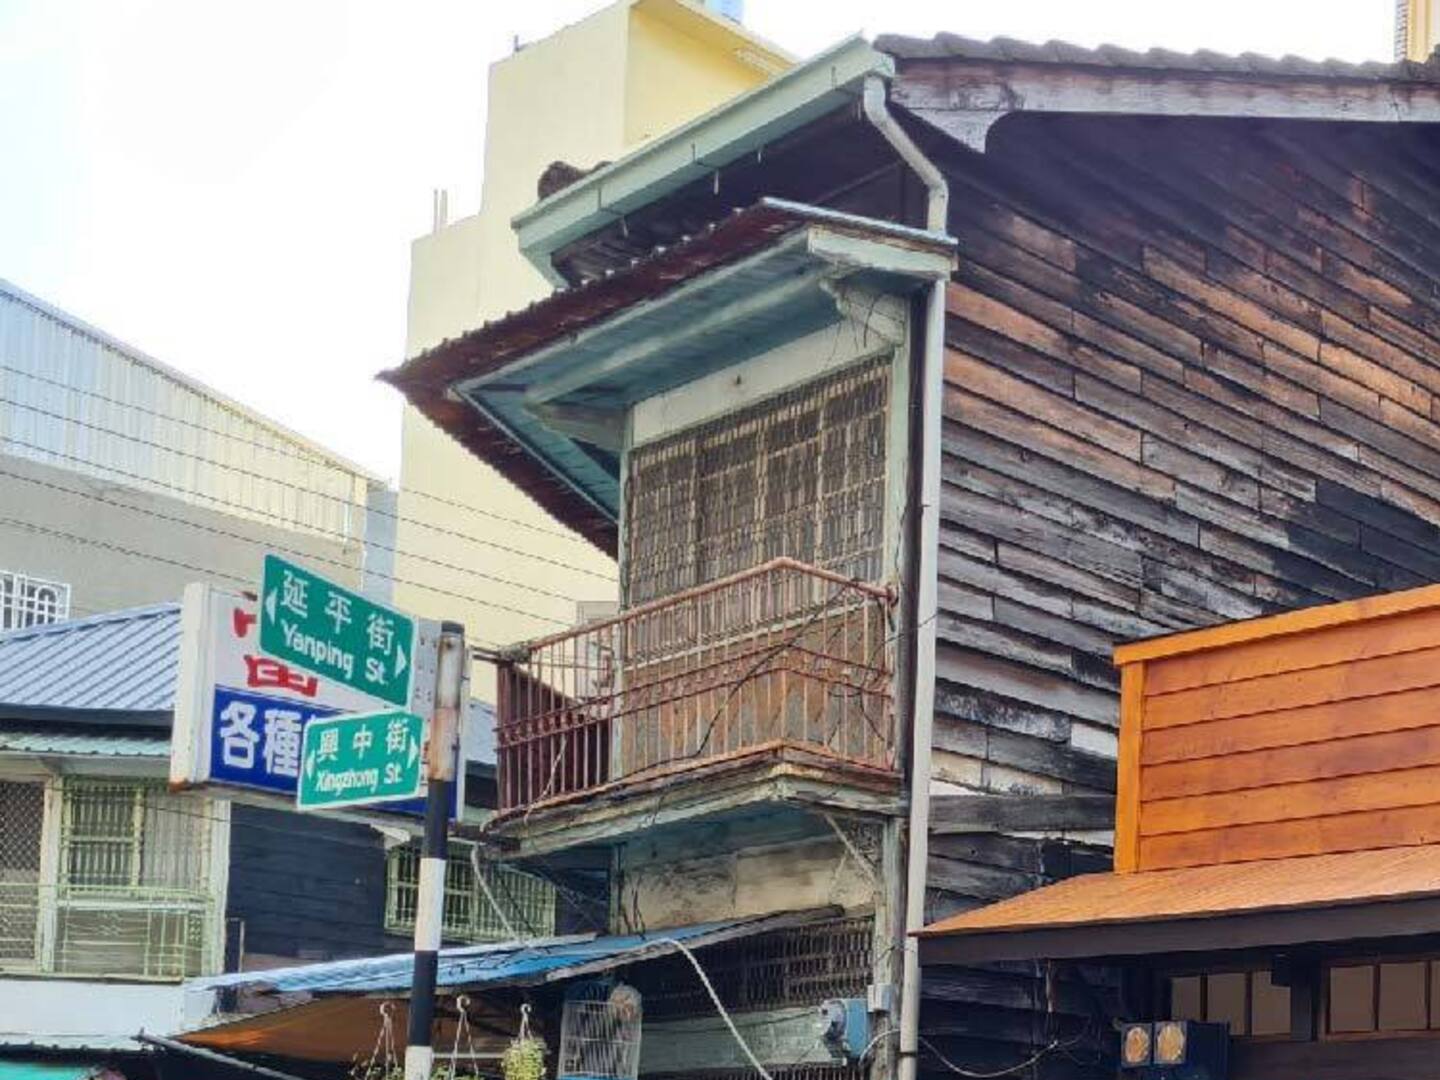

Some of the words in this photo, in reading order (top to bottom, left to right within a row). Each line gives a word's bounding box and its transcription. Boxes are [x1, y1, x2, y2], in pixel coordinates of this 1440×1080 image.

[280, 570, 394, 655] 延平街
[281, 620, 354, 679] Yanping
[219, 700, 316, 779] 各種
[316, 717, 410, 763] 興中街
[315, 768, 379, 793] Xingzhong
